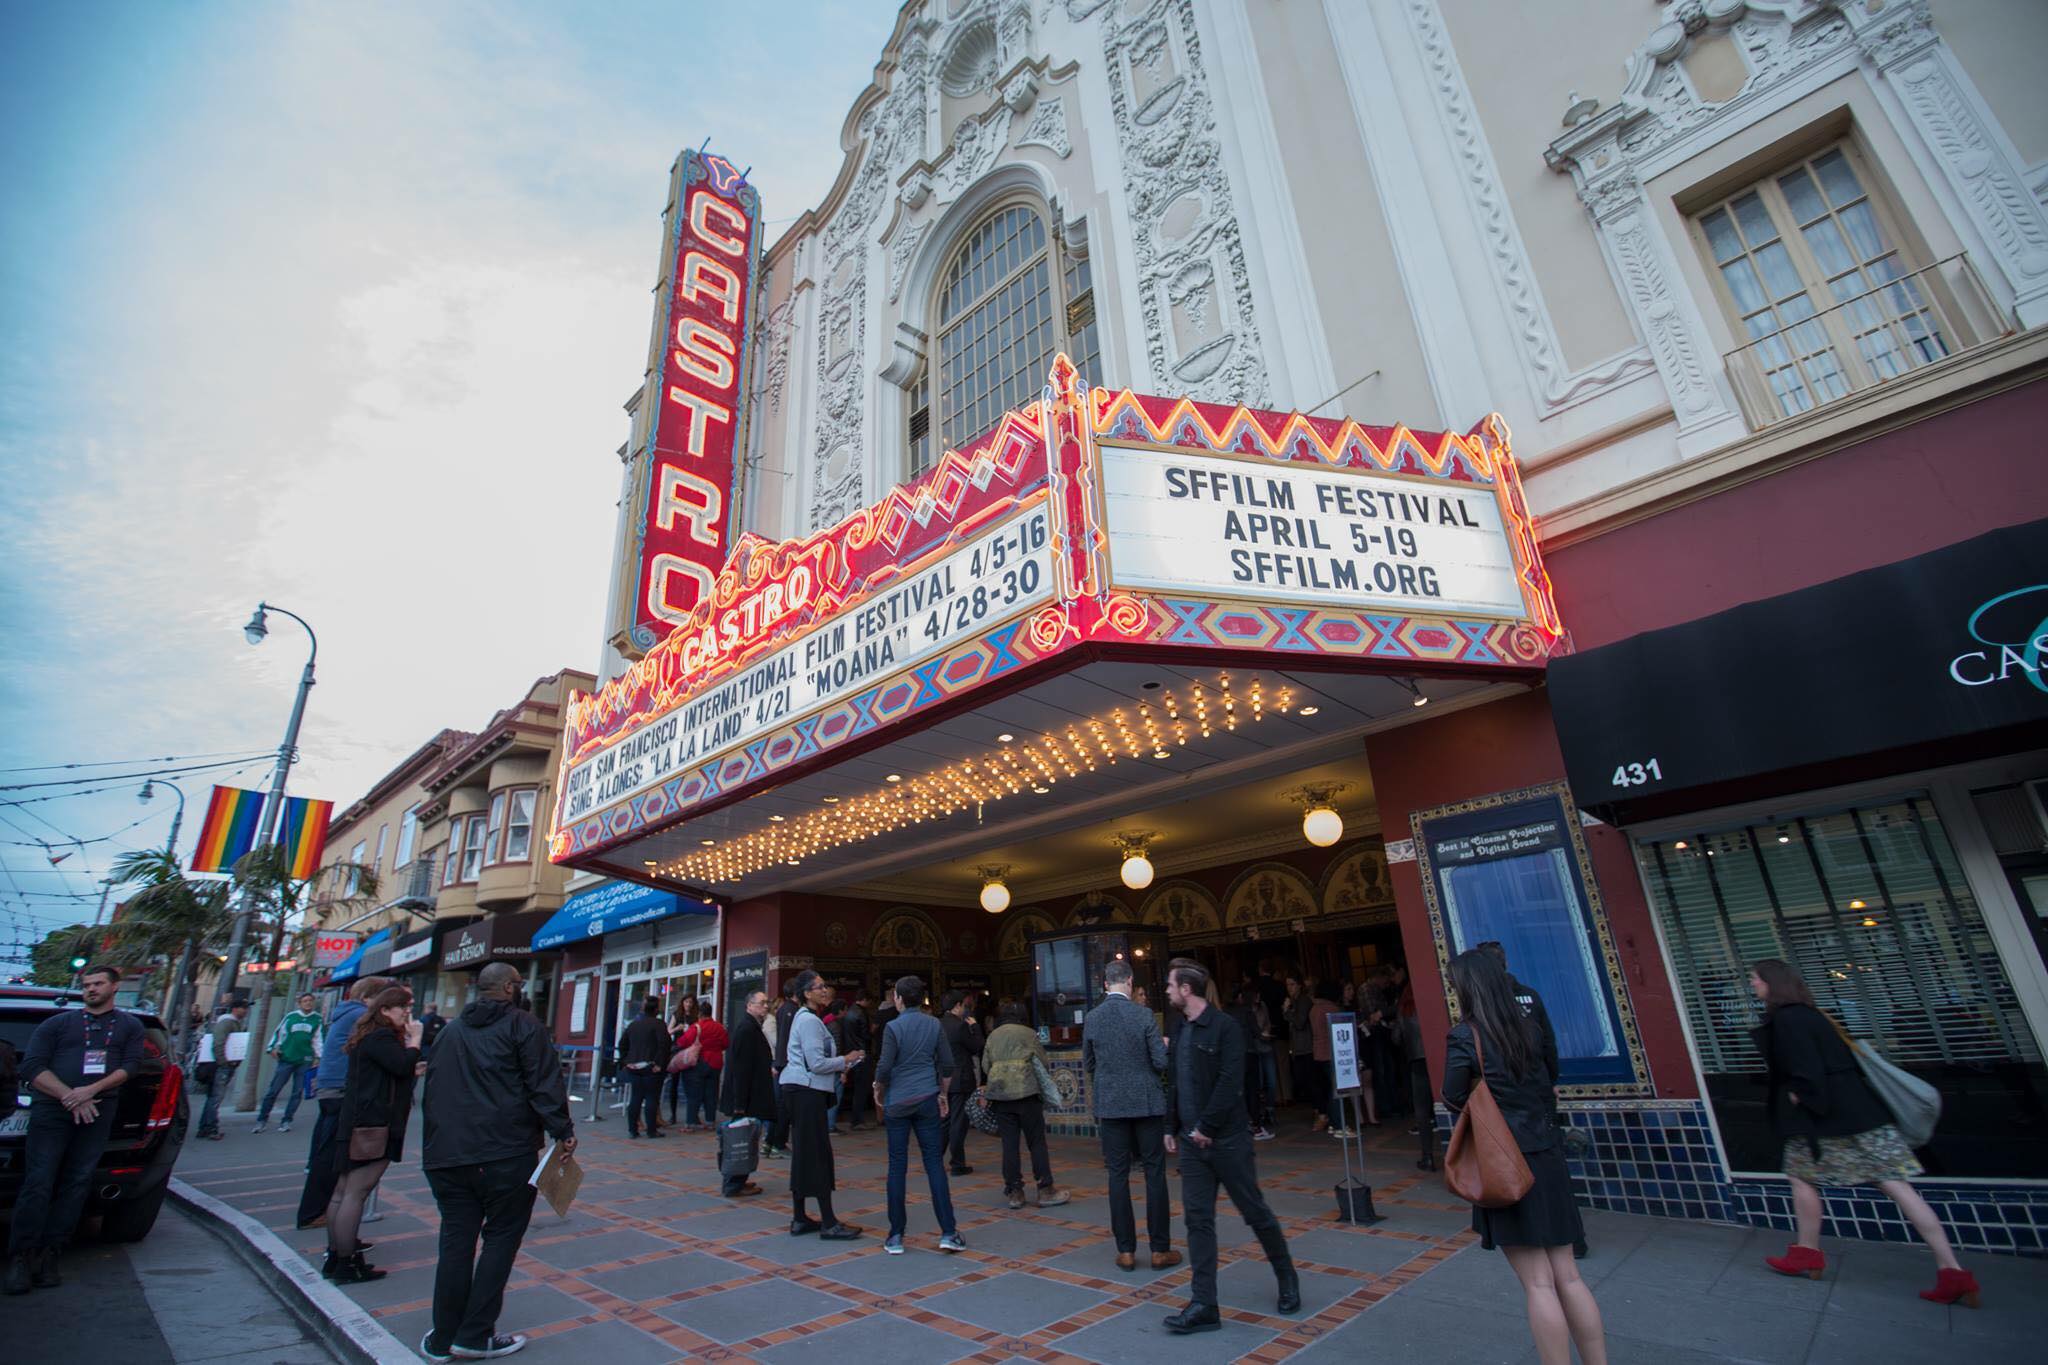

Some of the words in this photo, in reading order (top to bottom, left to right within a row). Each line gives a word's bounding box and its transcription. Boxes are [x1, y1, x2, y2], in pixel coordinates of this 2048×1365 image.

[648, 191, 746, 627] CASTRO
[1165, 468, 1295, 511] SFFILM
[1315, 484, 1480, 528] FESTIVAL
[1224, 510, 1331, 551] APRIL
[1350, 523, 1418, 559] 5-19
[1231, 549, 1441, 598] SFFILM.ORG
[680, 566, 811, 675] CASTRO
[596, 751, 616, 780] SAN
[619, 717, 678, 766] FRANCISCO
[684, 651, 796, 734] INTERNATIONAL
[806, 623, 845, 669] FILM
[856, 565, 956, 643] FESTIVAL
[970, 513, 1046, 579] 4/5-16
[569, 788, 593, 817] SING
[597, 763, 643, 804] ALONGS:
[679, 735, 696, 764] LA
[703, 706, 750, 750] LAND"
[756, 686, 791, 725] 4/21
[807, 626, 908, 698] "MOANA"
[924, 558, 1040, 642] 4/28-30
[1611, 757, 1663, 788] 431
[1460, 850, 1475, 859] and
[1476, 842, 1510, 856] Digital
[1512, 836, 1541, 850] Sound
[1470, 835, 1507, 847] Cinema
[1509, 823, 1556, 839] Projection
[316, 937, 356, 951] HOT
